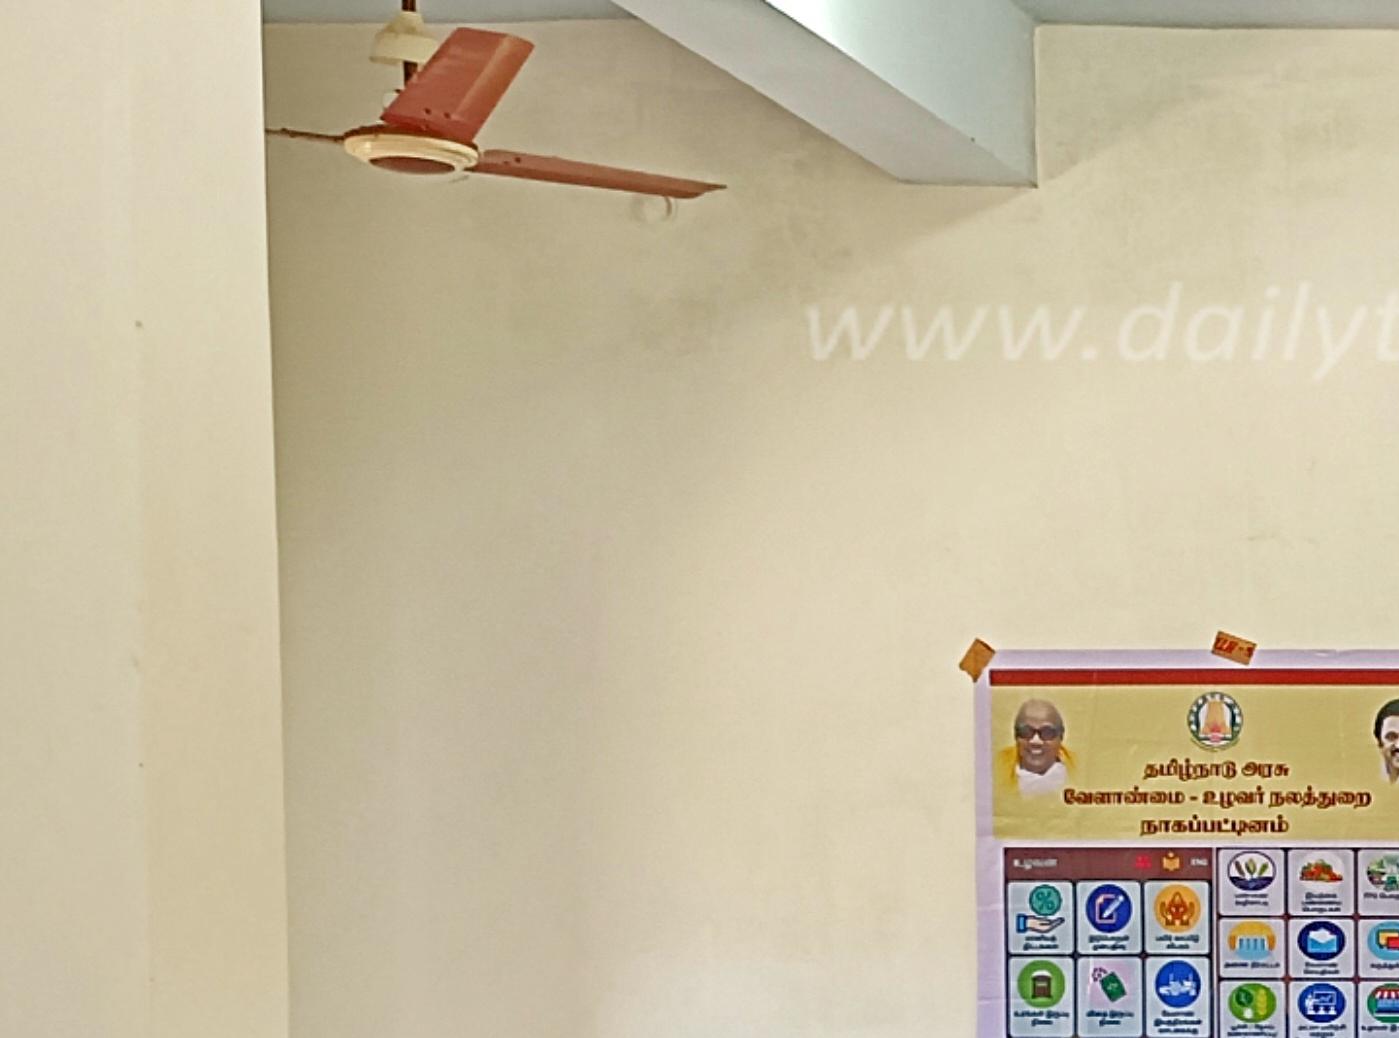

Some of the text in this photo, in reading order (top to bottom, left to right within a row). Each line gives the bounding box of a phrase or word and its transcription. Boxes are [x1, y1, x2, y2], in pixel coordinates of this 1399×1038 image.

[1142, 758, 1291, 780] தமிழ்நாடு அரசு
[1063, 787, 1184, 807] வேளாண்மை
[1202, 787, 1265, 810] உழவர்
[1268, 788, 1372, 811] நலத்துறை
[1139, 814, 1290, 836] நாகப்பட்டினம்
